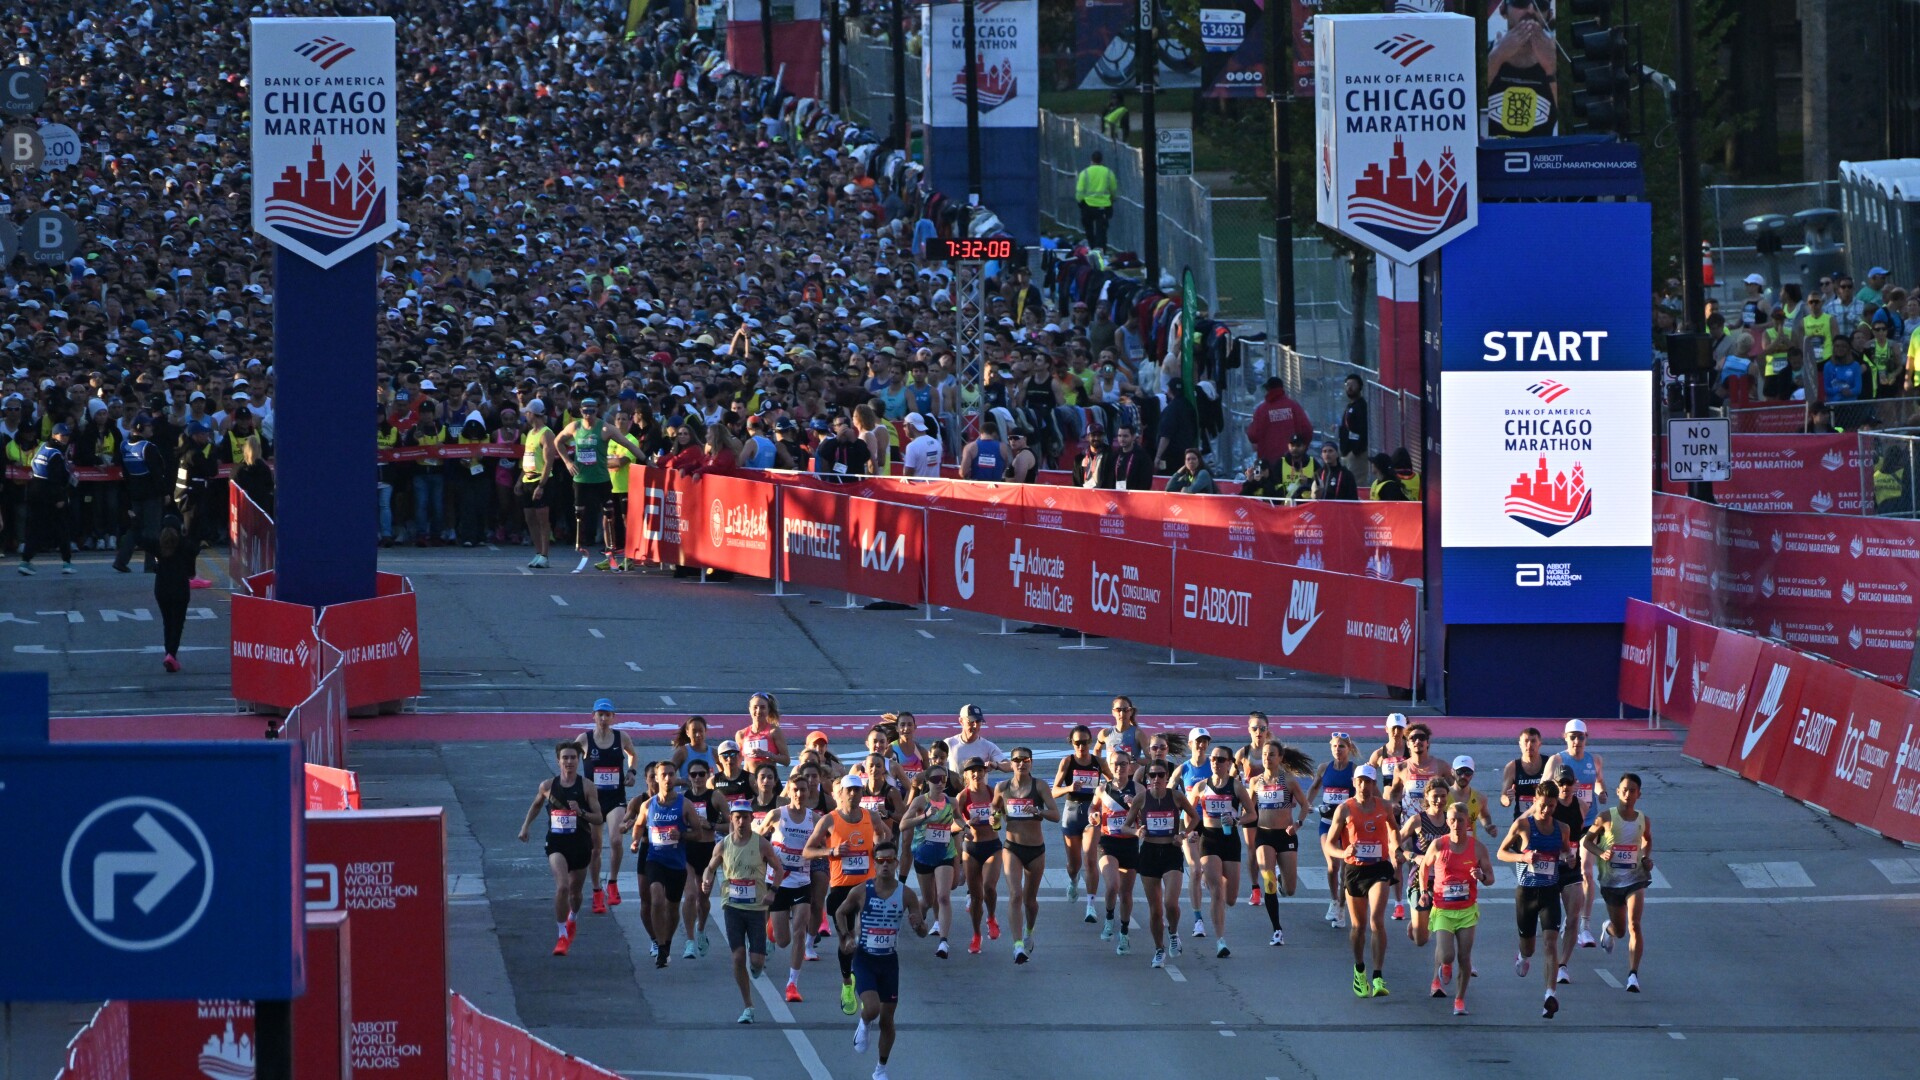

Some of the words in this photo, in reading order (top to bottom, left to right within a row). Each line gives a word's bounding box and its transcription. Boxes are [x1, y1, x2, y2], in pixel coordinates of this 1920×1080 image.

[952, 26, 1017, 38] CCAGO
[1210, 24, 1244, 36] 34921
[952, 40, 1017, 49] MATHON
[264, 77, 300, 86] BANK
[305, 77, 321, 86] OF
[324, 77, 385, 86] AMERICA
[1345, 74, 1381, 84] BANK
[1385, 75, 1401, 83] OF
[1405, 73, 1465, 83] AMERICA
[9, 72, 30, 100] C
[6, 101, 34, 110] Corral
[264, 91, 386, 114] CHICAGO
[1345, 88, 1466, 112] CHICAGO
[265, 118, 386, 135] MARATHON
[1346, 114, 1466, 133] MARATHON
[14, 133, 33, 160] B
[45, 142, 74, 156] :00
[39, 217, 62, 248] B
[34, 251, 64, 261] Corral
[1483, 331, 1608, 361] START
[1505, 419, 1592, 436] CHICAGO
[1688, 427, 1711, 439] NO
[1505, 439, 1592, 451] MARATHON
[1682, 444, 1718, 456] TURN
[1675, 461, 1692, 473] ON
[1754, 460, 1804, 469] MARATHON
[1744, 502, 1793, 510] MARATHON
[664, 517, 689, 532] MARATHON
[1163, 523, 1189, 531] CHICAGO
[1229, 526, 1255, 534] CHICAGO
[664, 531, 682, 544] MAJORS
[783, 517, 841, 561] BIOFREEZE
[1294, 530, 1323, 538] CHICAGO
[1364, 531, 1392, 540] CHICAGO
[1785, 541, 1808, 551] CHICAGO
[1808, 543, 1840, 554] MARATHON
[1866, 547, 1890, 557] CHICAGO
[1890, 548, 1920, 559] MARATHON
[1026, 547, 1065, 579] Advocate
[1122, 564, 1139, 581] TATA
[1092, 560, 1120, 615] tcs
[1778, 586, 1801, 597] CHICAGO
[1802, 588, 1832, 599] MARATHON
[1024, 582, 1052, 610] Health
[1053, 586, 1073, 614] Care
[1121, 584, 1161, 604] CONSULTANCY
[1858, 592, 1882, 602] CHICAGO
[1882, 593, 1913, 604] MARATHON
[1201, 586, 1252, 627] ABBOTT
[1289, 579, 1318, 622] RUN
[1121, 603, 1147, 620] SERVICES
[1347, 619, 1364, 636] BANK
[1365, 623, 1373, 638] OF
[1373, 624, 1398, 643] AMERICA
[1786, 632, 1809, 643] CHICAGO
[1809, 633, 1839, 645] MARATHON
[1865, 638, 1889, 648] CHICAGO
[233, 640, 253, 659] BANK
[255, 643, 264, 659] OF
[264, 646, 295, 665] AMERICA
[352, 649, 360, 664] OF
[362, 641, 397, 662] AMERICA
[1416, 781, 1425, 789] 53
[654, 813, 678, 821] Dirigo
[976, 808, 989, 816] 564
[1153, 818, 1168, 826] 519
[933, 830, 945, 838] 541
[848, 857, 863, 865] 540
[1535, 861, 1549, 870] 509
[344, 862, 394, 874] ABBOTT
[345, 875, 392, 886] WORLD
[344, 886, 417, 897] MARATHON
[735, 886, 748, 894] 491
[344, 898, 396, 909] MAJORS
[874, 935, 889, 944] 404
[198, 1007, 255, 1019] MARATH
[351, 1034, 396, 1045] WORLD
[351, 1045, 421, 1056] MARATHON
[351, 1057, 399, 1068] MAJORS
